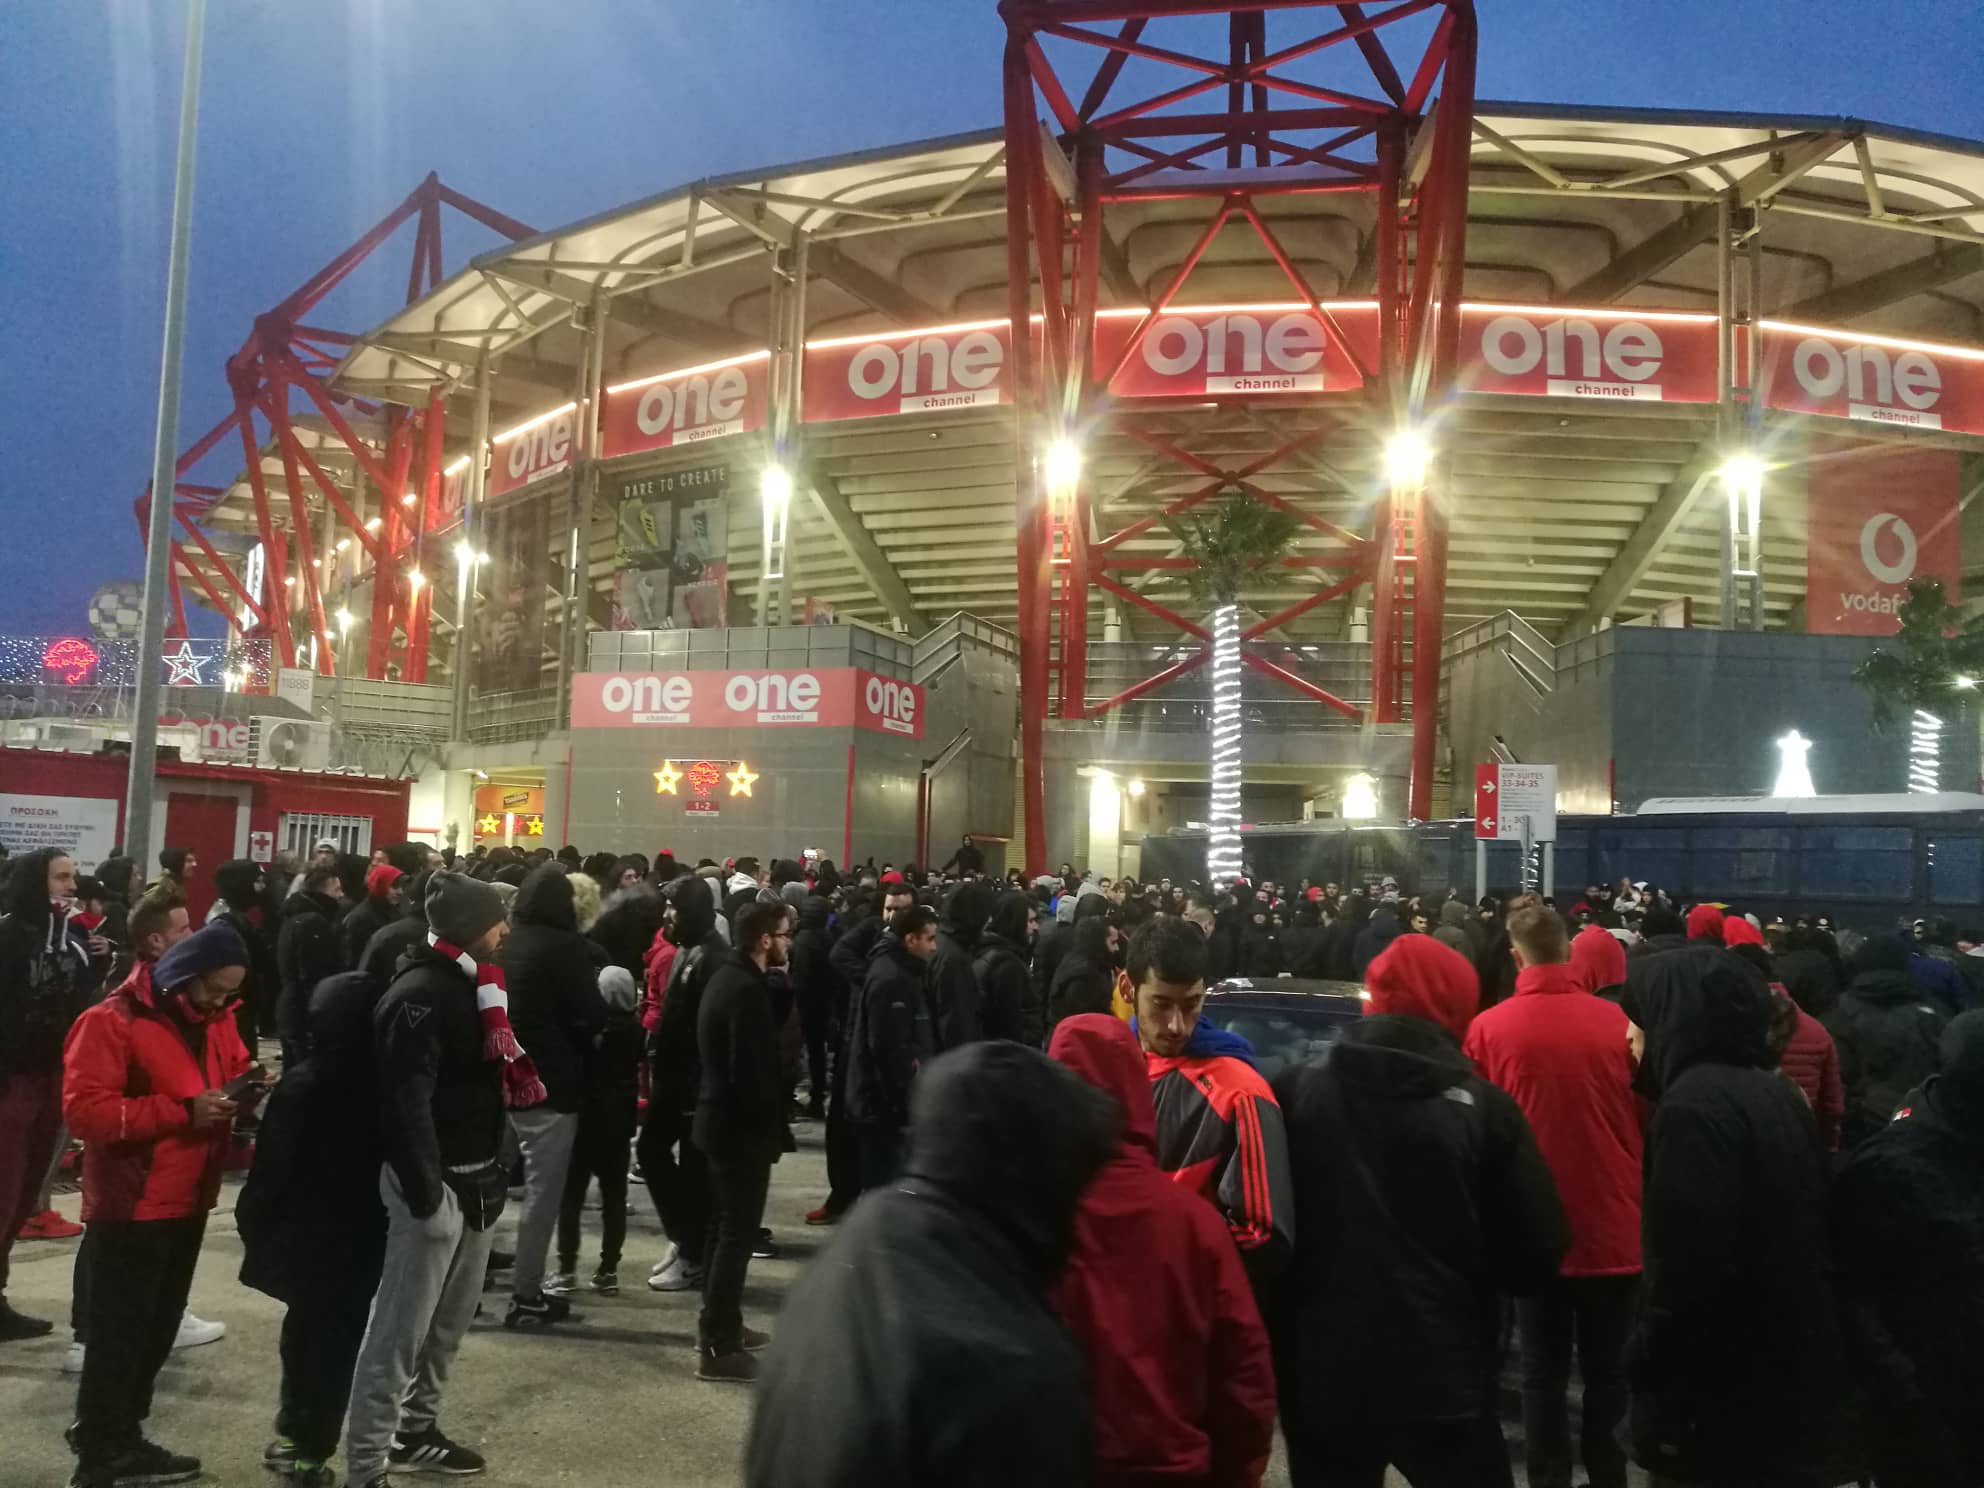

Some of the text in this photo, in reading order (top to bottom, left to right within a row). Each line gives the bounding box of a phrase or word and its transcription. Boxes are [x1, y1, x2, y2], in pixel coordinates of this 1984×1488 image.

[1142, 313, 1327, 376] one
[1481, 316, 1664, 382] one
[848, 331, 1004, 400] one
[1234, 377, 1296, 390] channel
[1793, 337, 1942, 410] one
[637, 367, 748, 436] one
[923, 393, 976, 408] channel
[1575, 384, 1635, 397] channel
[688, 425, 727, 441] channel
[1871, 408, 1921, 424] channel
[508, 414, 572, 479] one
[624, 467, 726, 498] DARE TO CREATE
[1840, 590, 1905, 614] vodaf
[602, 675, 693, 712] one
[725, 673, 821, 712] one
[866, 676, 915, 722] one
